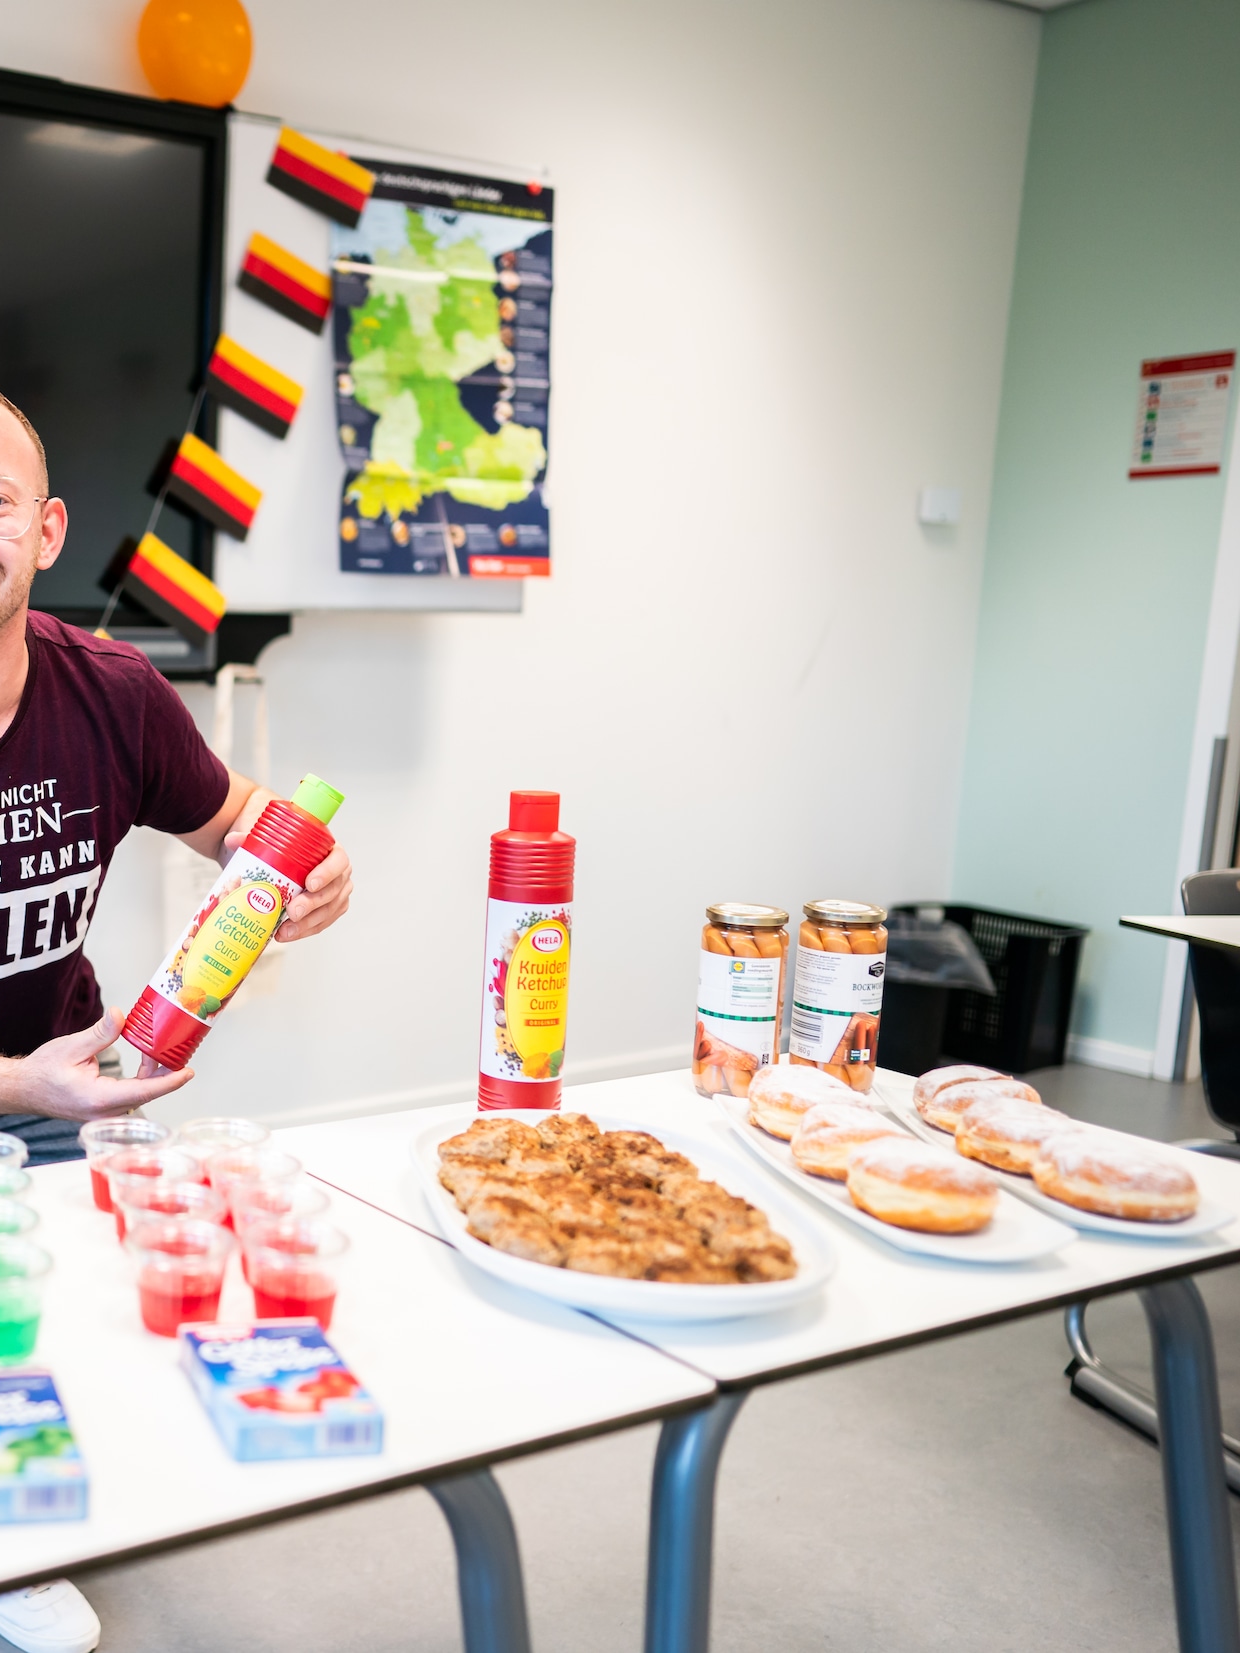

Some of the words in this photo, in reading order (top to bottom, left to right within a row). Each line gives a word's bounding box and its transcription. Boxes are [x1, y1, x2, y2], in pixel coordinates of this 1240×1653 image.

[0, 778, 57, 807] NICHT
[20, 840, 96, 880] KANN
[252, 893, 271, 909] HELA
[225, 906, 266, 939] Gewürz
[214, 916, 259, 951] Ketchup
[214, 940, 240, 961] Curry
[520, 960, 567, 974] Kruiden
[517, 976, 566, 991] Ketchup
[530, 999, 558, 1010] Curry
